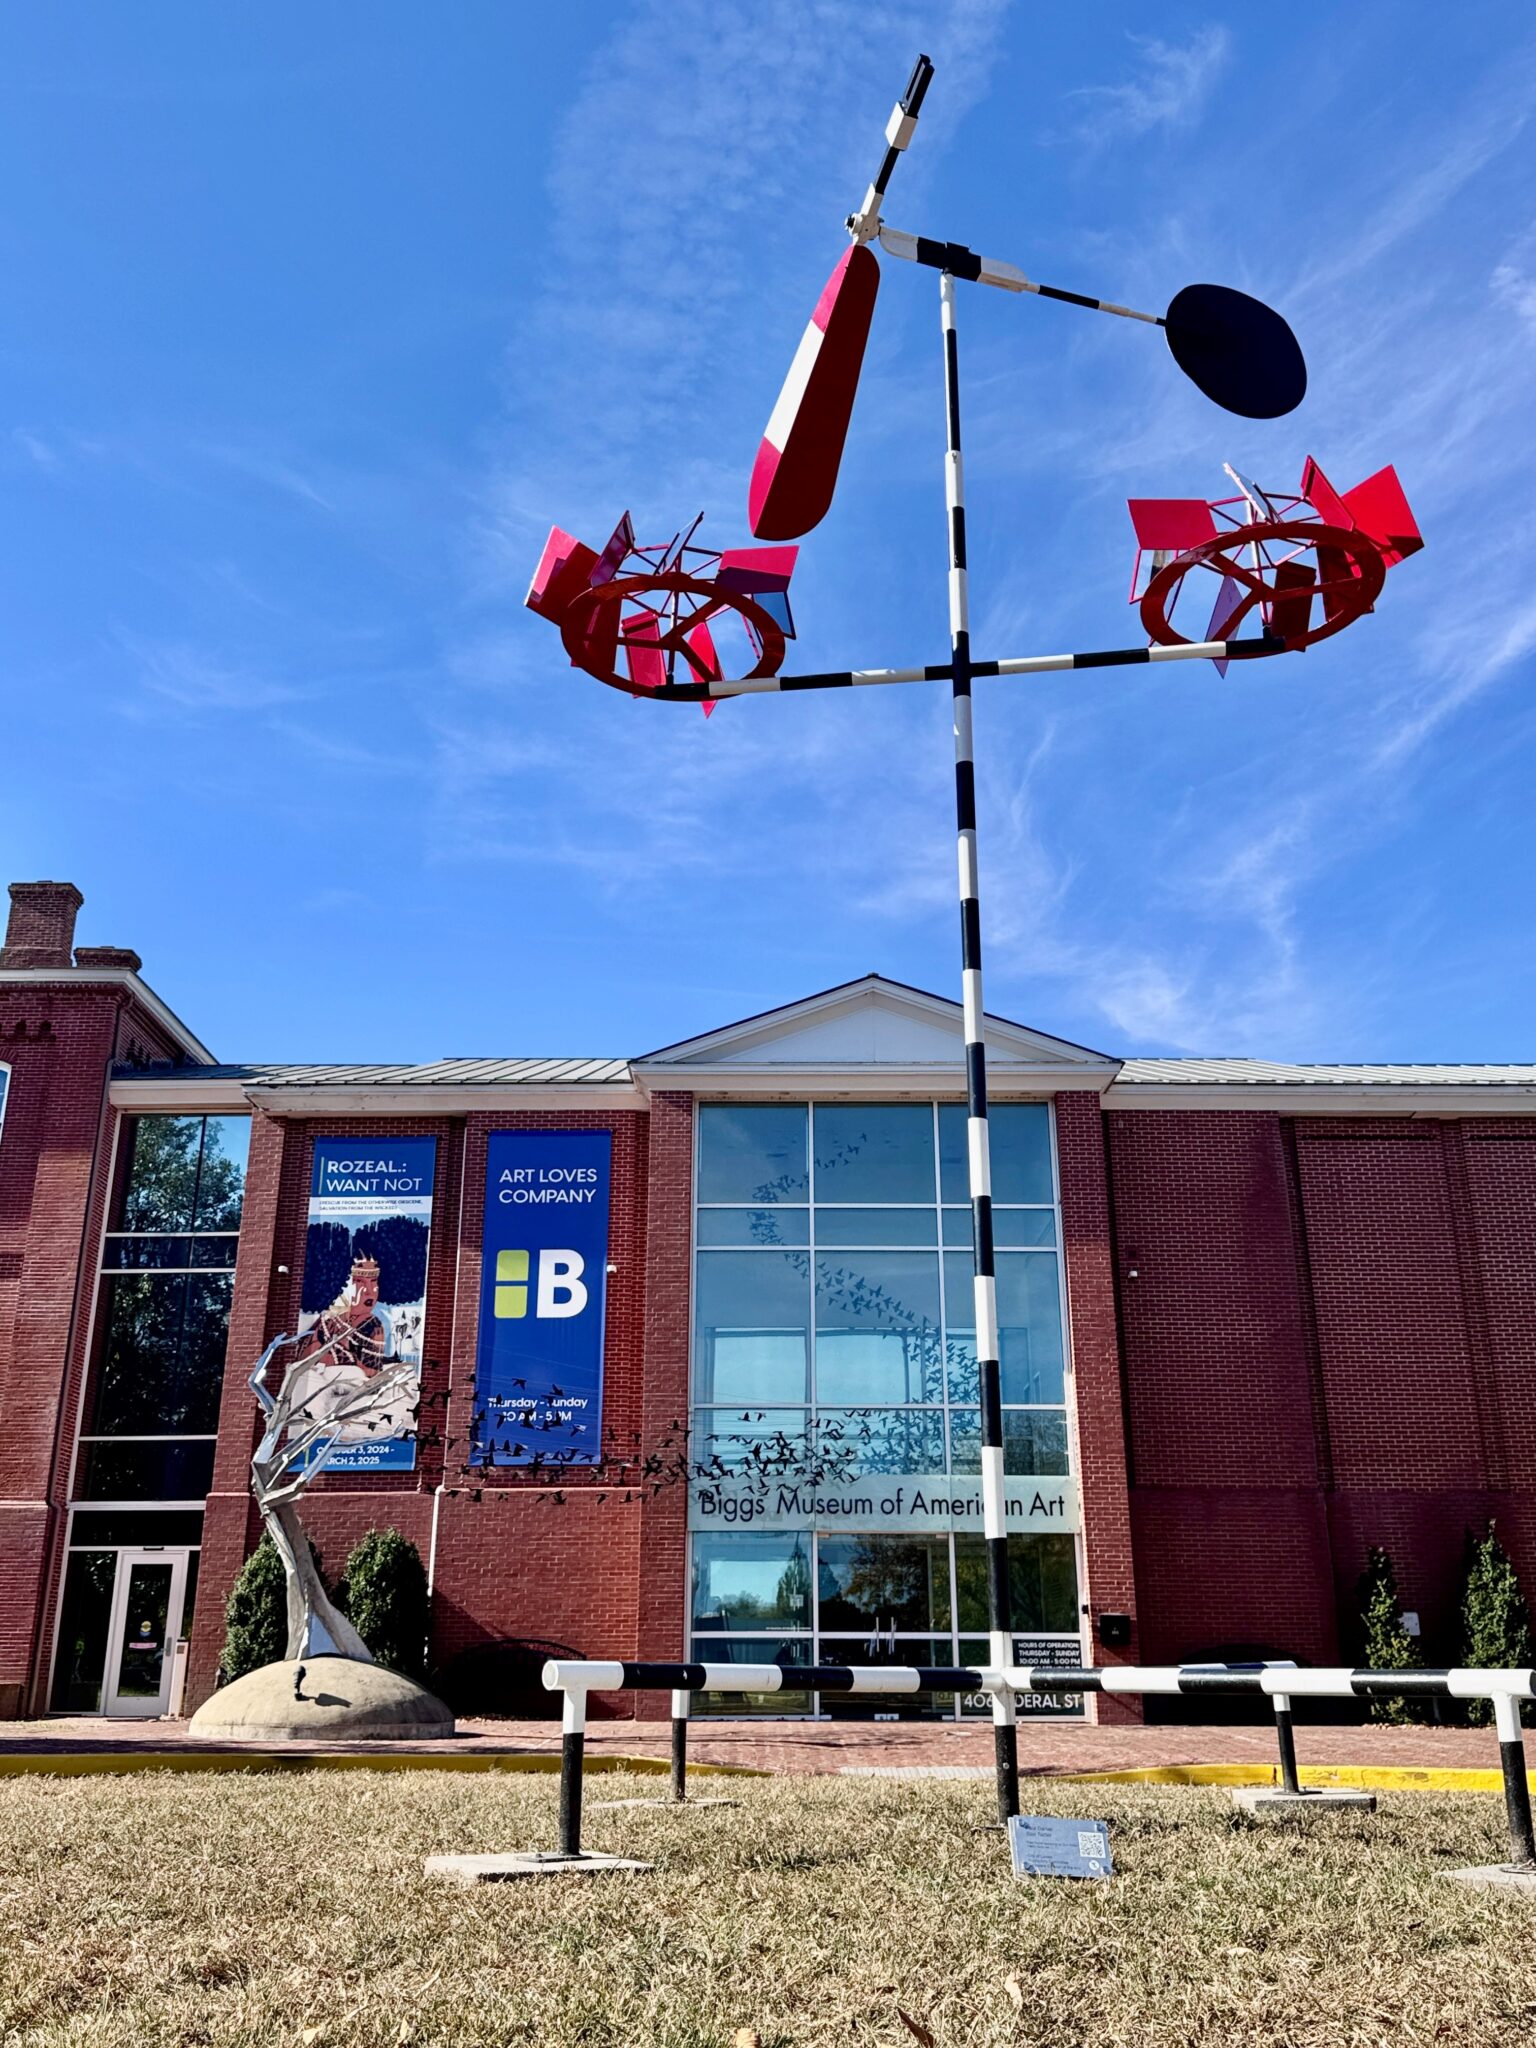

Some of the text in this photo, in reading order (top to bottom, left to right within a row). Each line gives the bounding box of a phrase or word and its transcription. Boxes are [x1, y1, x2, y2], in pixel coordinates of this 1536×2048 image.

[499, 1168, 598, 1183] ART LOVES
[326, 1177, 423, 1192] WANT NOT
[499, 1189, 597, 1204] COMPANY
[545, 1411, 553, 1422] 5
[367, 1445, 390, 1454] 2024
[348, 1456, 357, 1466] 2,
[357, 1456, 380, 1465] 2025
[700, 1488, 1065, 1522] Biggs Museum of Amerin Art
[1064, 1694, 1081, 1708] ST
